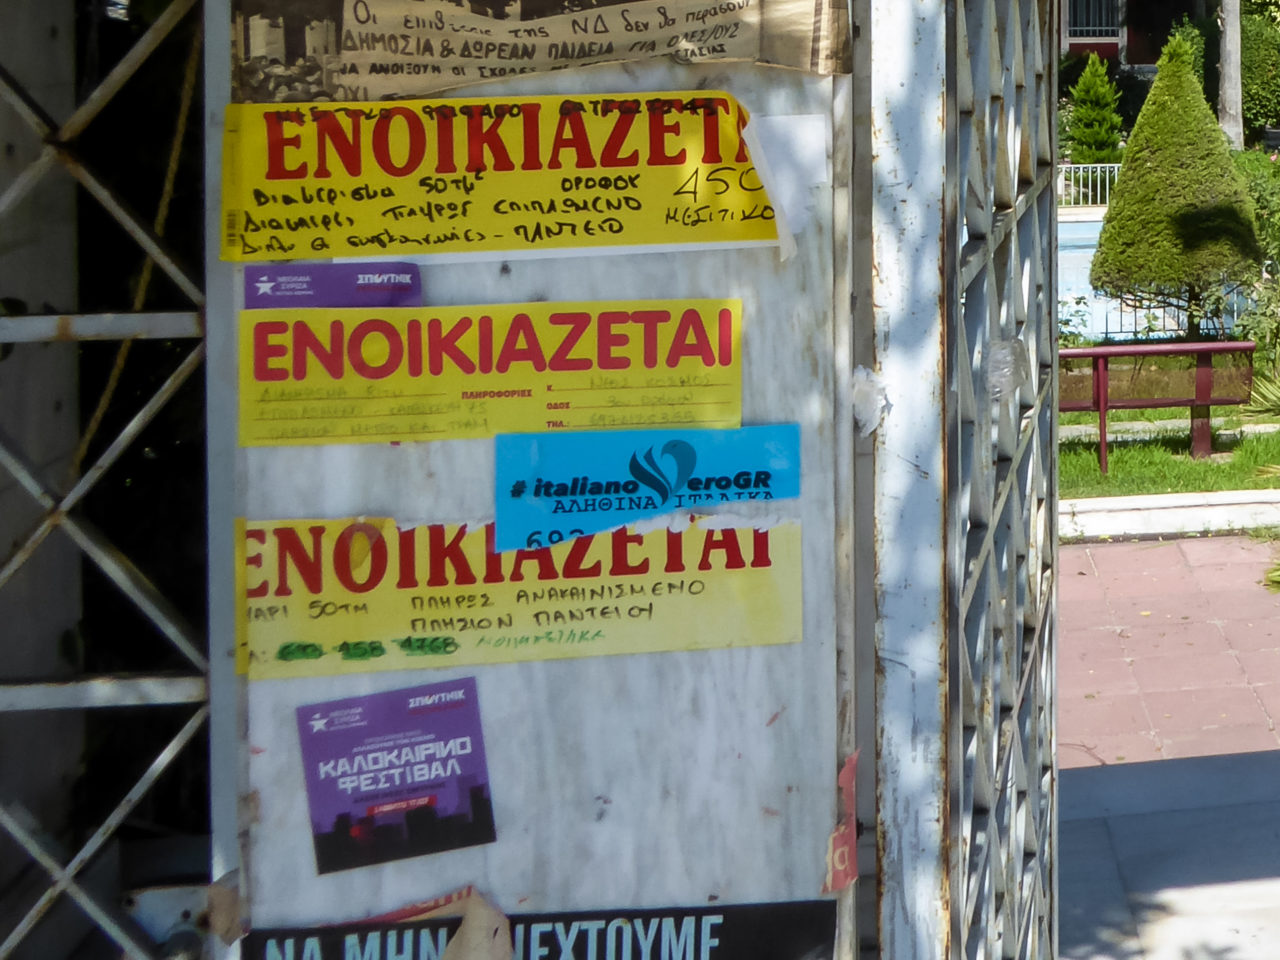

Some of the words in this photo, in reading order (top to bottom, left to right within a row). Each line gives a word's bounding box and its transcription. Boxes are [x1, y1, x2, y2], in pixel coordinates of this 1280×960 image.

[572, 14, 610, 35] ΝΔ
[621, 9, 649, 33] δεν
[657, 6, 676, 29] θα
[342, 29, 435, 57] ΔΗΜΟΣΙΑ
[439, 40, 456, 58] &
[548, 41, 614, 59] ΠΑΙΔΕΙΑ
[628, 41, 657, 53] ΓΙΑ
[452, 66, 466, 77] ΟΙ
[253, 308, 733, 382] ΕΝΟΙΚΙΑΖΕΤΑΙ
[461, 390, 533, 400] ΠΛΗΡΟΦΟΡΙΕΣ
[551, 495, 659, 514] ΑΛΗΘΙΝΑ
